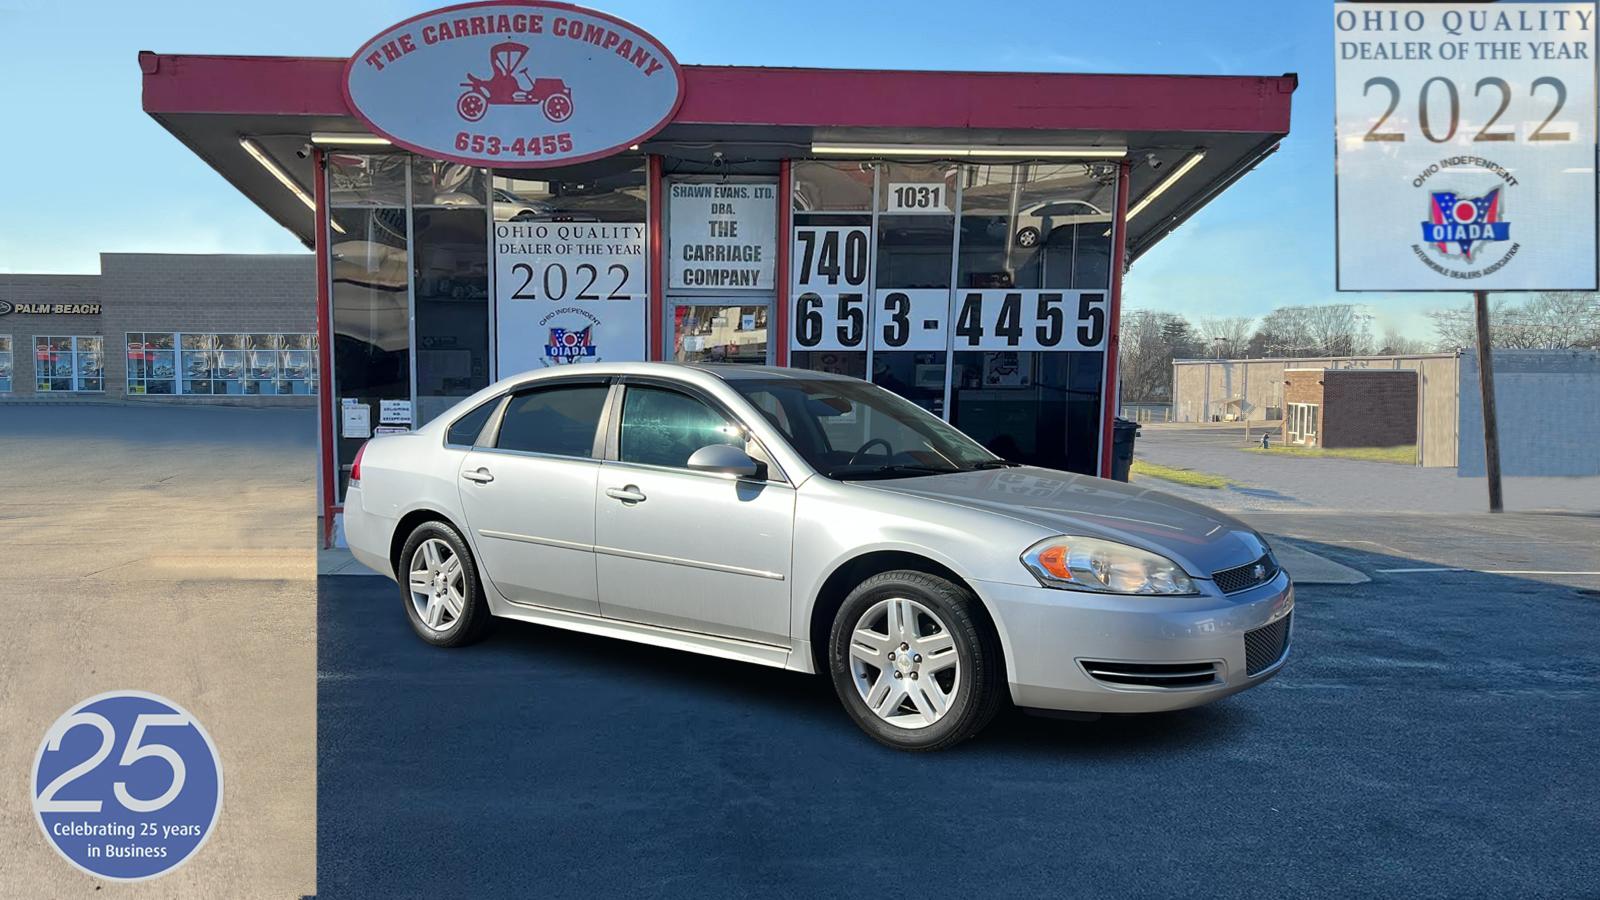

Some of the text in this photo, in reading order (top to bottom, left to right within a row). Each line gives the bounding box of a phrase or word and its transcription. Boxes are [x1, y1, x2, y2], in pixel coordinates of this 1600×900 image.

[1336, 10, 1593, 36] OHIO QUALITY
[365, 14, 664, 77] THE CARRIAGE COMPANY
[1340, 41, 1589, 60] DEALER OF THE YEAR
[1362, 76, 1571, 143] 2022
[454, 132, 573, 156] 653-4455
[1412, 155, 1520, 188] OHIO INDEPENDENT
[672, 186, 712, 198] SHAWN
[753, 187, 775, 199] LTD.
[894, 186, 940, 209] 1031
[711, 203, 736, 215] DBA.
[496, 226, 644, 241] OHIO QUALITY
[709, 220, 738, 238] THE
[1432, 224, 1495, 241] OIADA
[499, 243, 642, 255] DEALER OF THE YEAR
[683, 244, 762, 262] CARRIAGE
[797, 230, 868, 286] 740
[1411, 242, 1521, 280] AUTOMOBILE DEALERS ASSOCIATION
[511, 262, 632, 301] 2022
[683, 268, 761, 286] COMPANY
[14, 303, 51, 314] PALM
[539, 307, 602, 327] OHIO INDEPENDENT
[550, 346, 588, 356] OIADA
